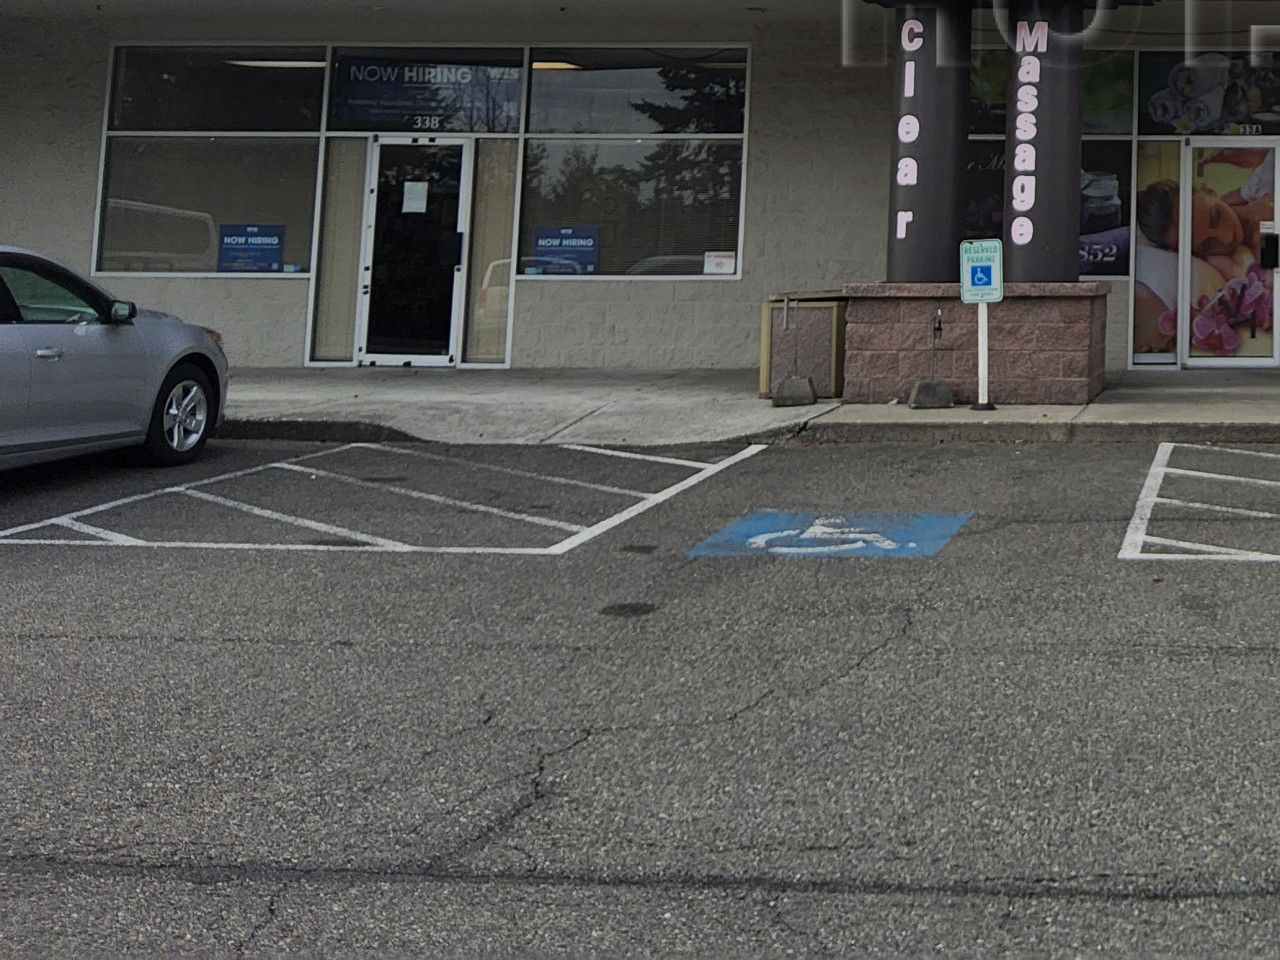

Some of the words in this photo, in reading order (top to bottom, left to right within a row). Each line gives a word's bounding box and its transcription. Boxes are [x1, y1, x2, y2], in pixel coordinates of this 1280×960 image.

[349, 65, 399, 81] NOW
[403, 66, 473, 84] HIRING
[895, 18, 924, 240] Clear
[1010, 20, 1049, 246] Massage
[224, 236, 247, 244] NOW
[247, 236, 279, 245] HIRING
[538, 238, 560, 246] NOW
[562, 238, 594, 246] HIRING
